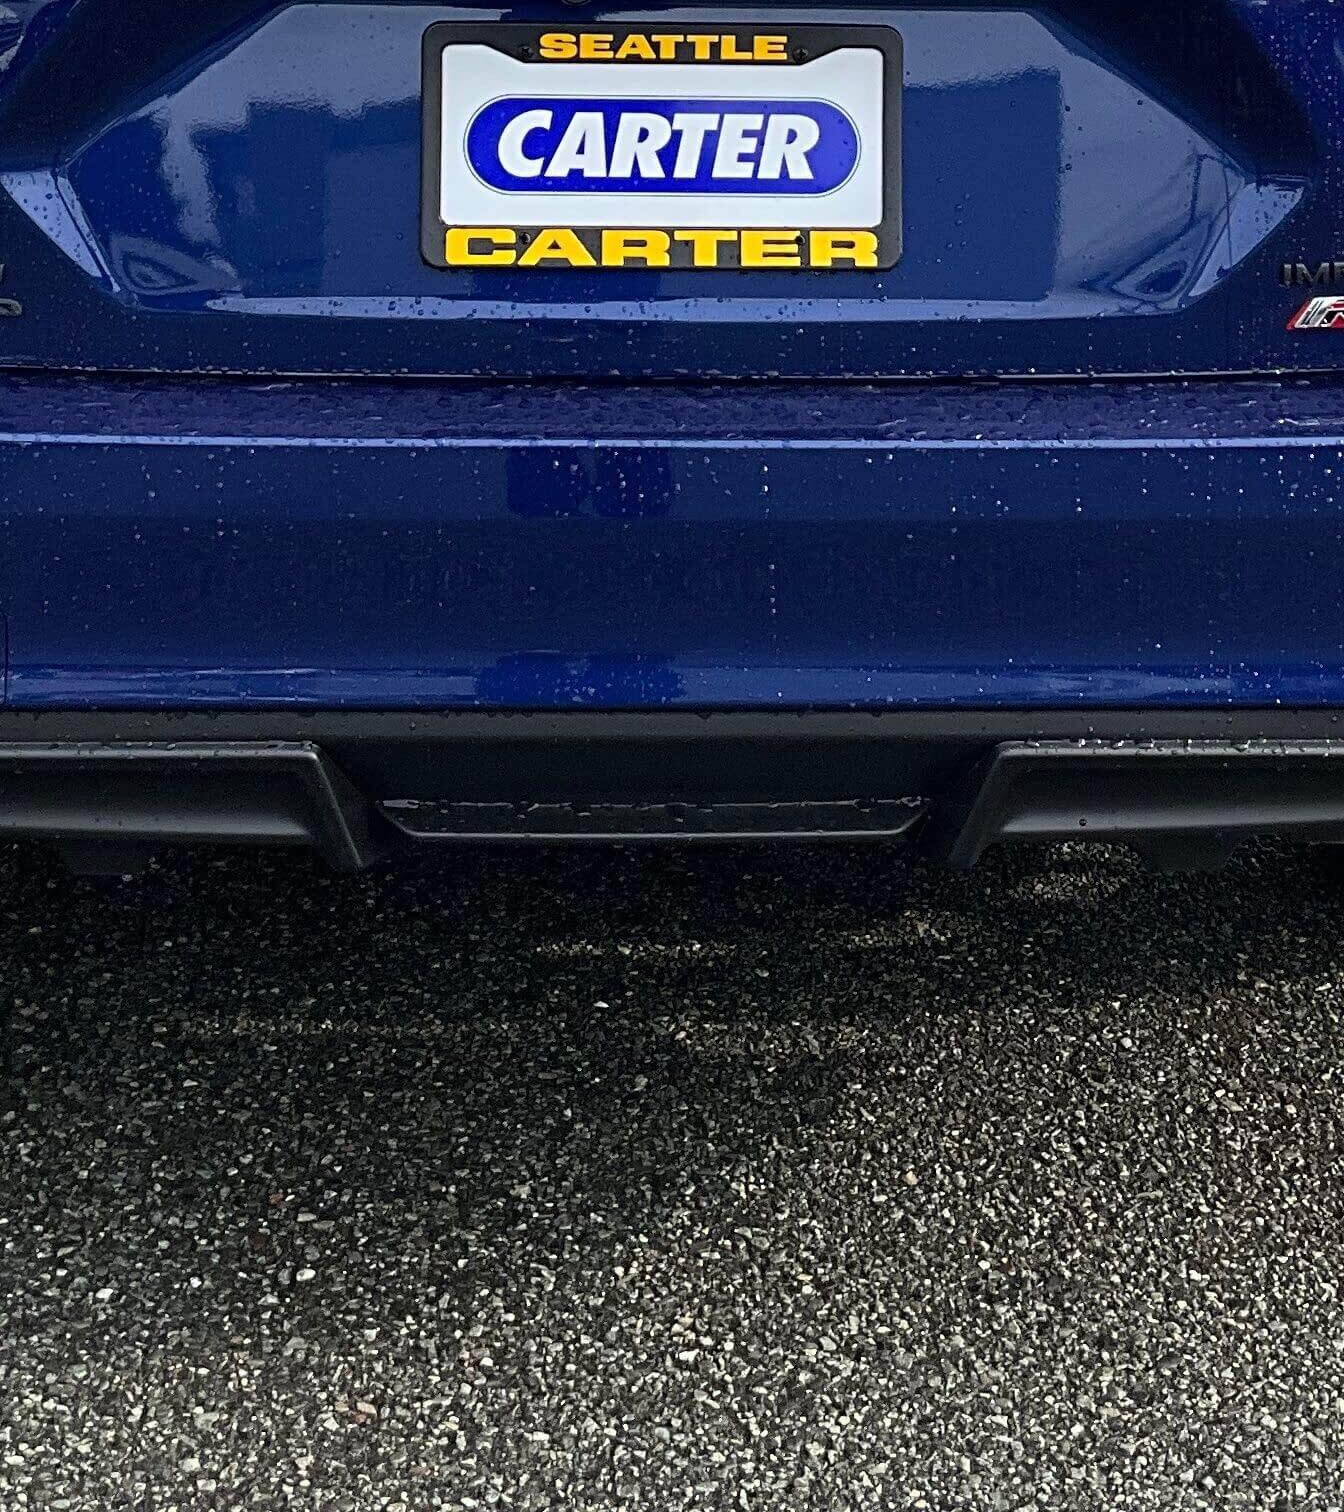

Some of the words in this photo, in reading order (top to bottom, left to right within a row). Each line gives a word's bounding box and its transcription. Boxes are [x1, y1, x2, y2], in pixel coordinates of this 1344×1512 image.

[539, 33, 788, 61] SEATTLE
[497, 109, 820, 180] CARTER
[444, 228, 879, 268] CARTER
